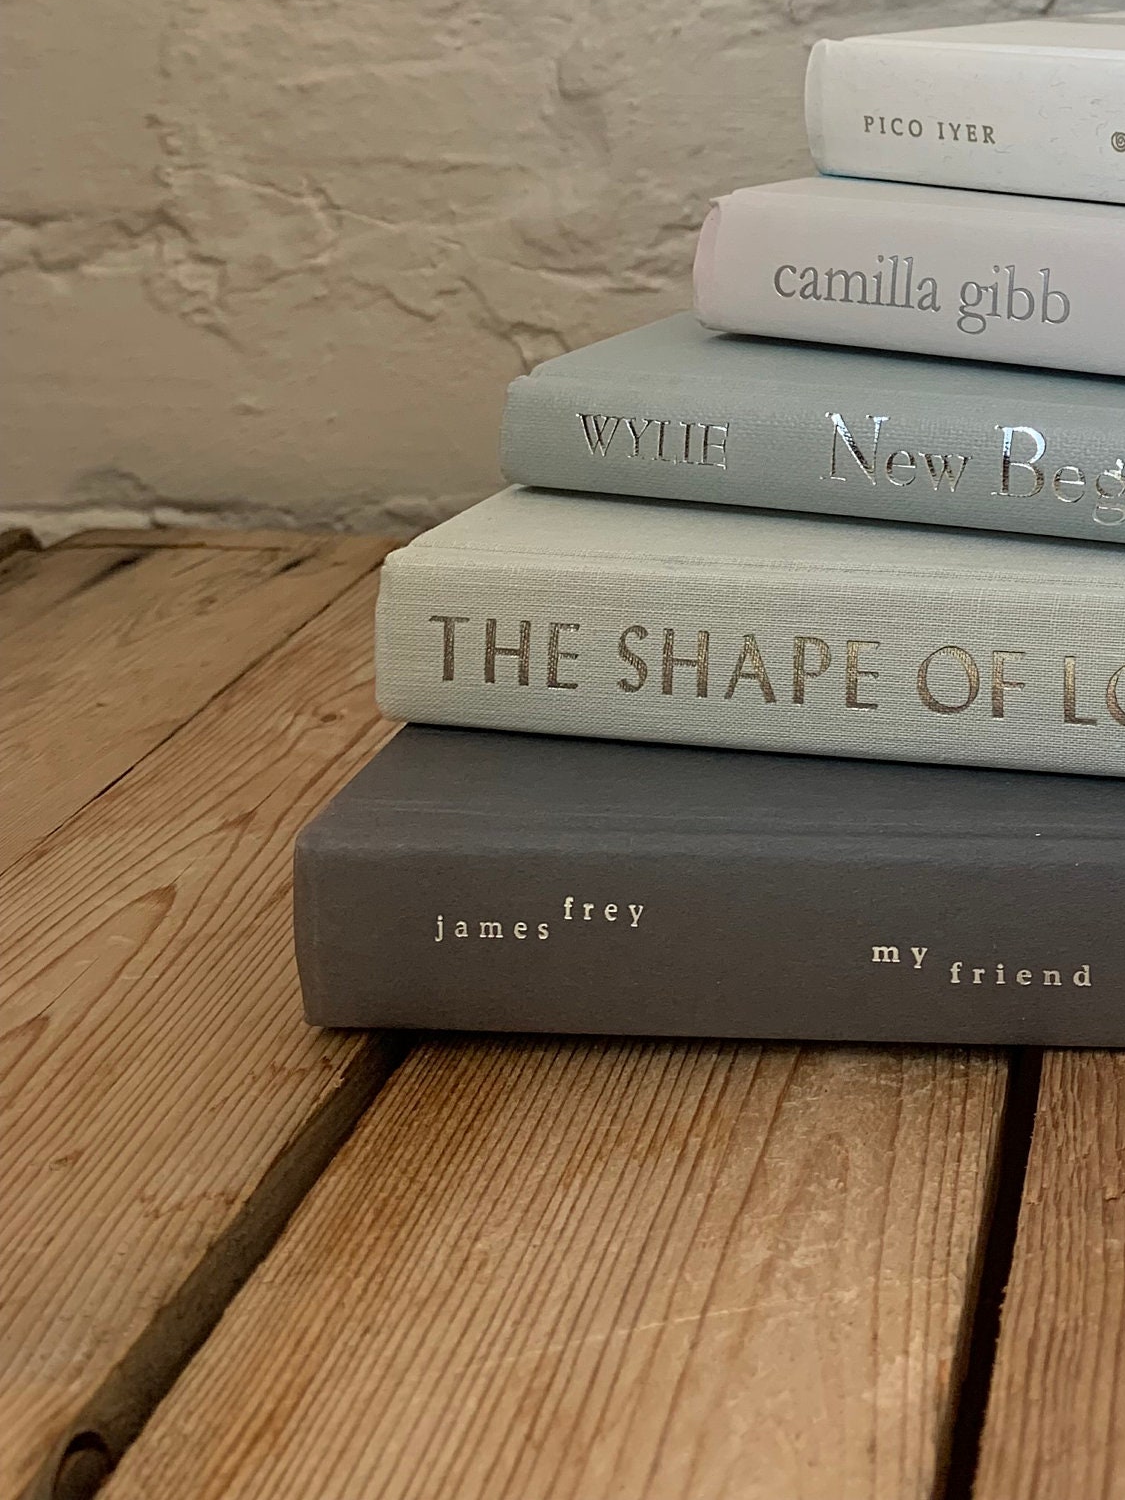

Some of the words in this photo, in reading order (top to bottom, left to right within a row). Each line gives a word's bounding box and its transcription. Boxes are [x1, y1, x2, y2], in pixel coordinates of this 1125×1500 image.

[863, 115, 923, 138] PICO
[938, 121, 996, 145] IYER
[774, 254, 940, 312] camilla
[957, 265, 1071, 335] gibb
[576, 412, 729, 470] WYLIE
[819, 411, 973, 492] New
[428, 615, 580, 689] THE
[617, 624, 881, 711] SHAPE
[917, 645, 1026, 720] OF
[435, 915, 549, 941] james
[563, 897, 644, 927] frey
[872, 944, 928, 969] my
[950, 962, 1092, 987] friend
